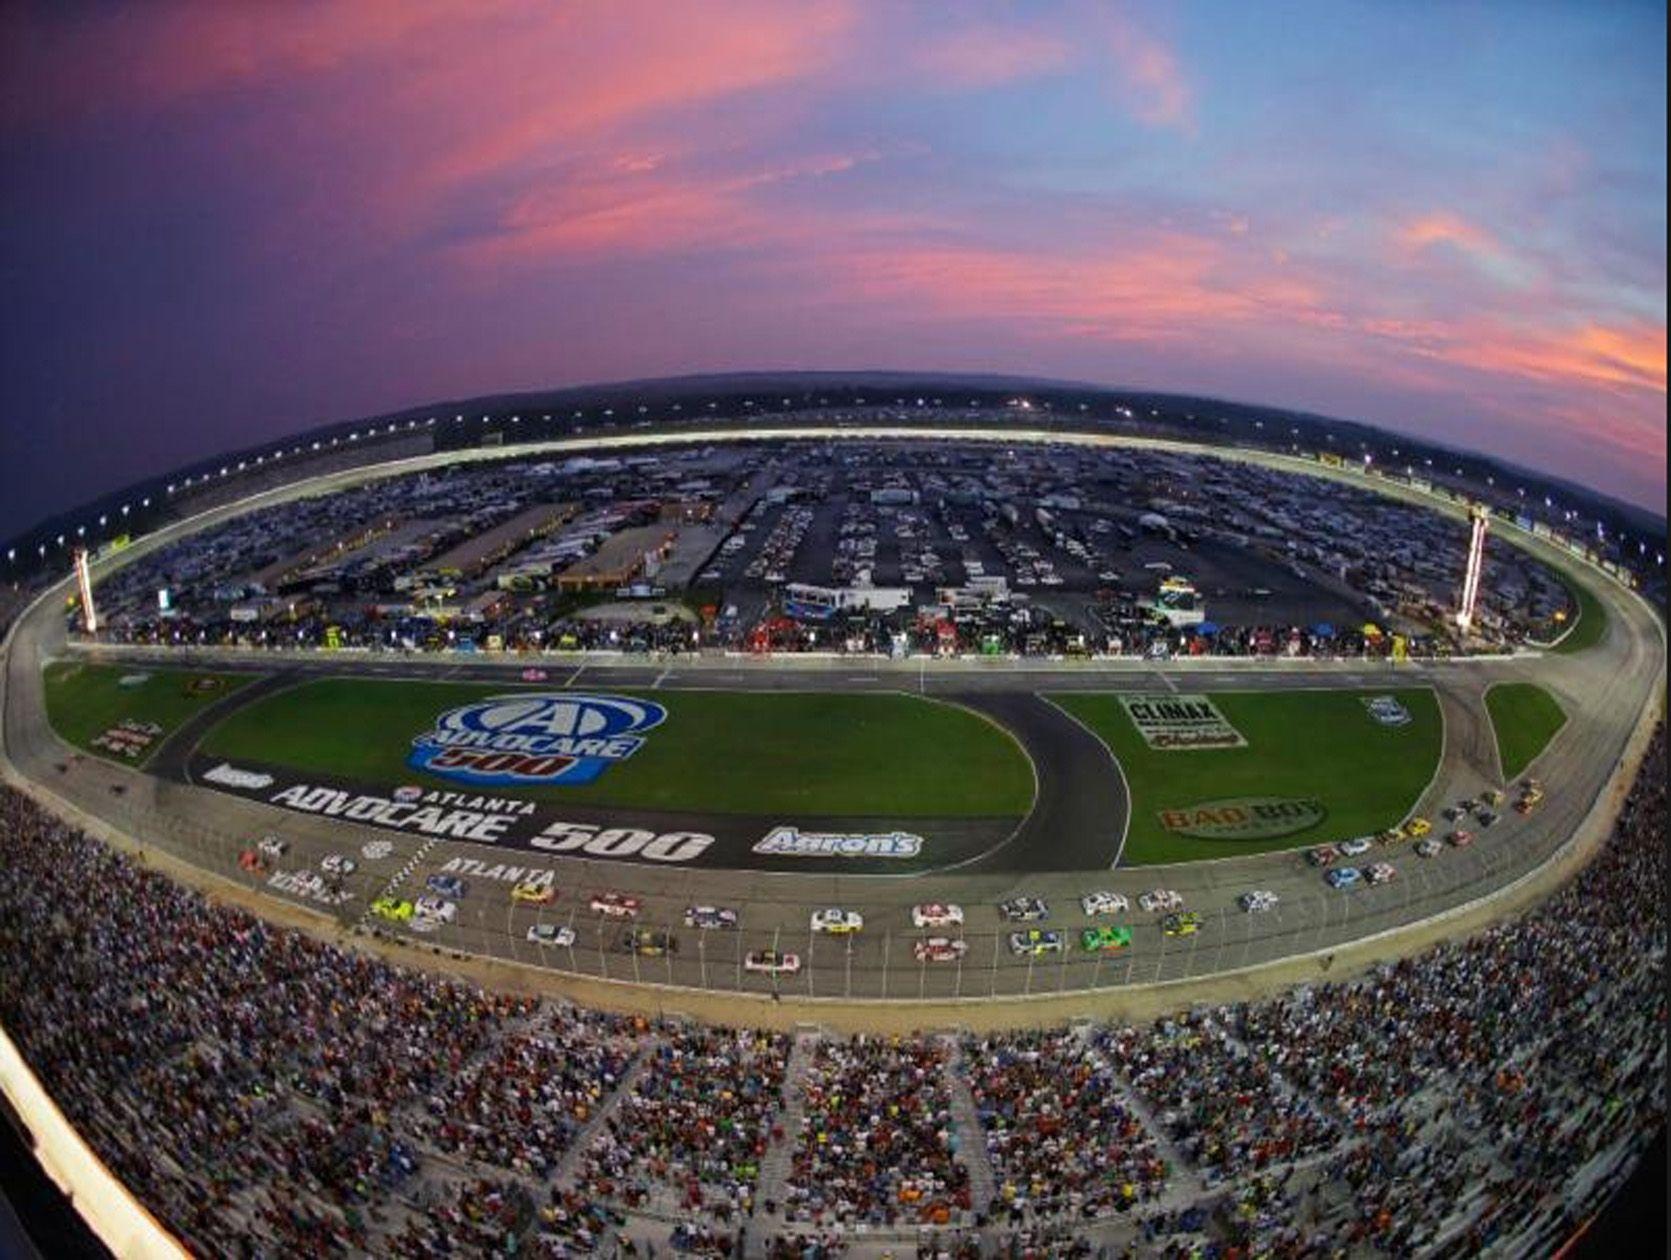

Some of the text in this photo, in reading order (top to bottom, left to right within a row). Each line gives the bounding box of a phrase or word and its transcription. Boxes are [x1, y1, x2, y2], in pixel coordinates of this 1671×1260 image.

[1129, 702, 1218, 720] CLIMAX
[428, 747, 576, 778] 500
[423, 791, 536, 815] ATLANTA
[1162, 807, 1247, 828] BAD
[270, 785, 714, 863] ADVOCARE 500
[752, 827, 924, 858] Aaron's
[441, 857, 555, 886] ATLANTA
